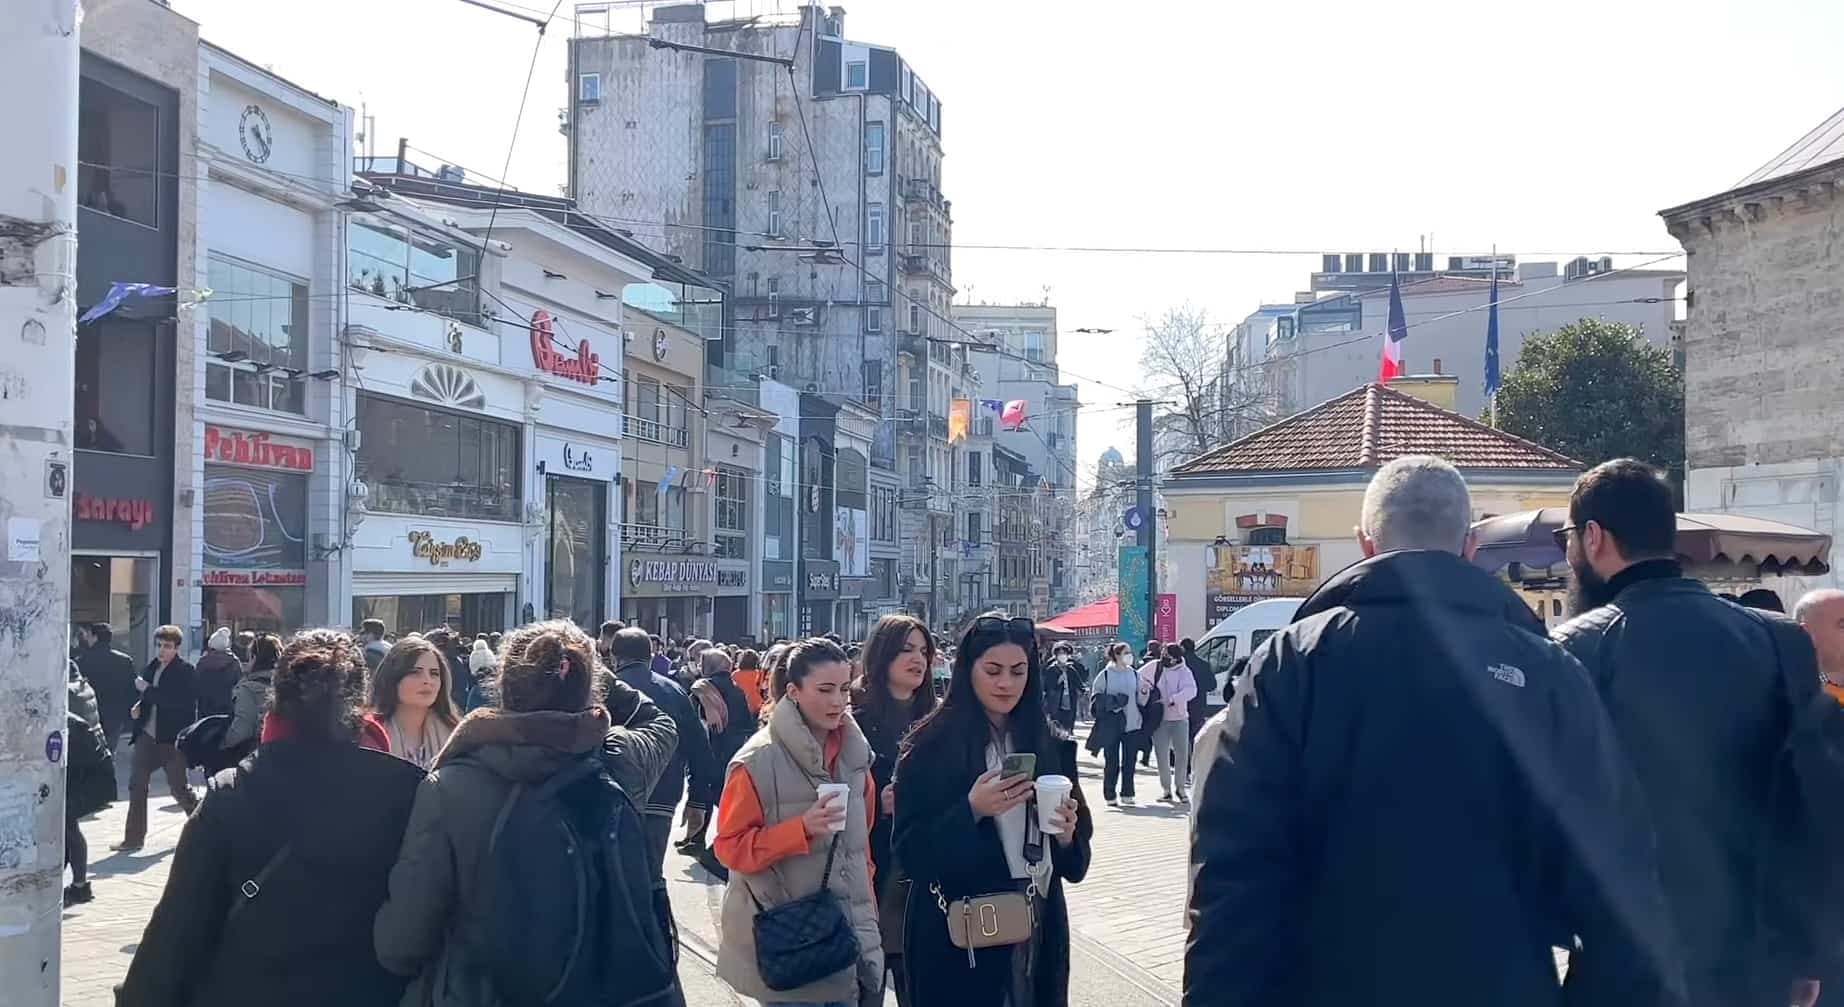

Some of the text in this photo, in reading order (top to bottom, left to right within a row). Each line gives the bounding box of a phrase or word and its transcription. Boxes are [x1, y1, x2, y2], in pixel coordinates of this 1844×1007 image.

[205, 427, 312, 470] Pehlivan
[645, 560, 678, 581] KEBAP
[680, 558, 718, 582] DÜNYASI
